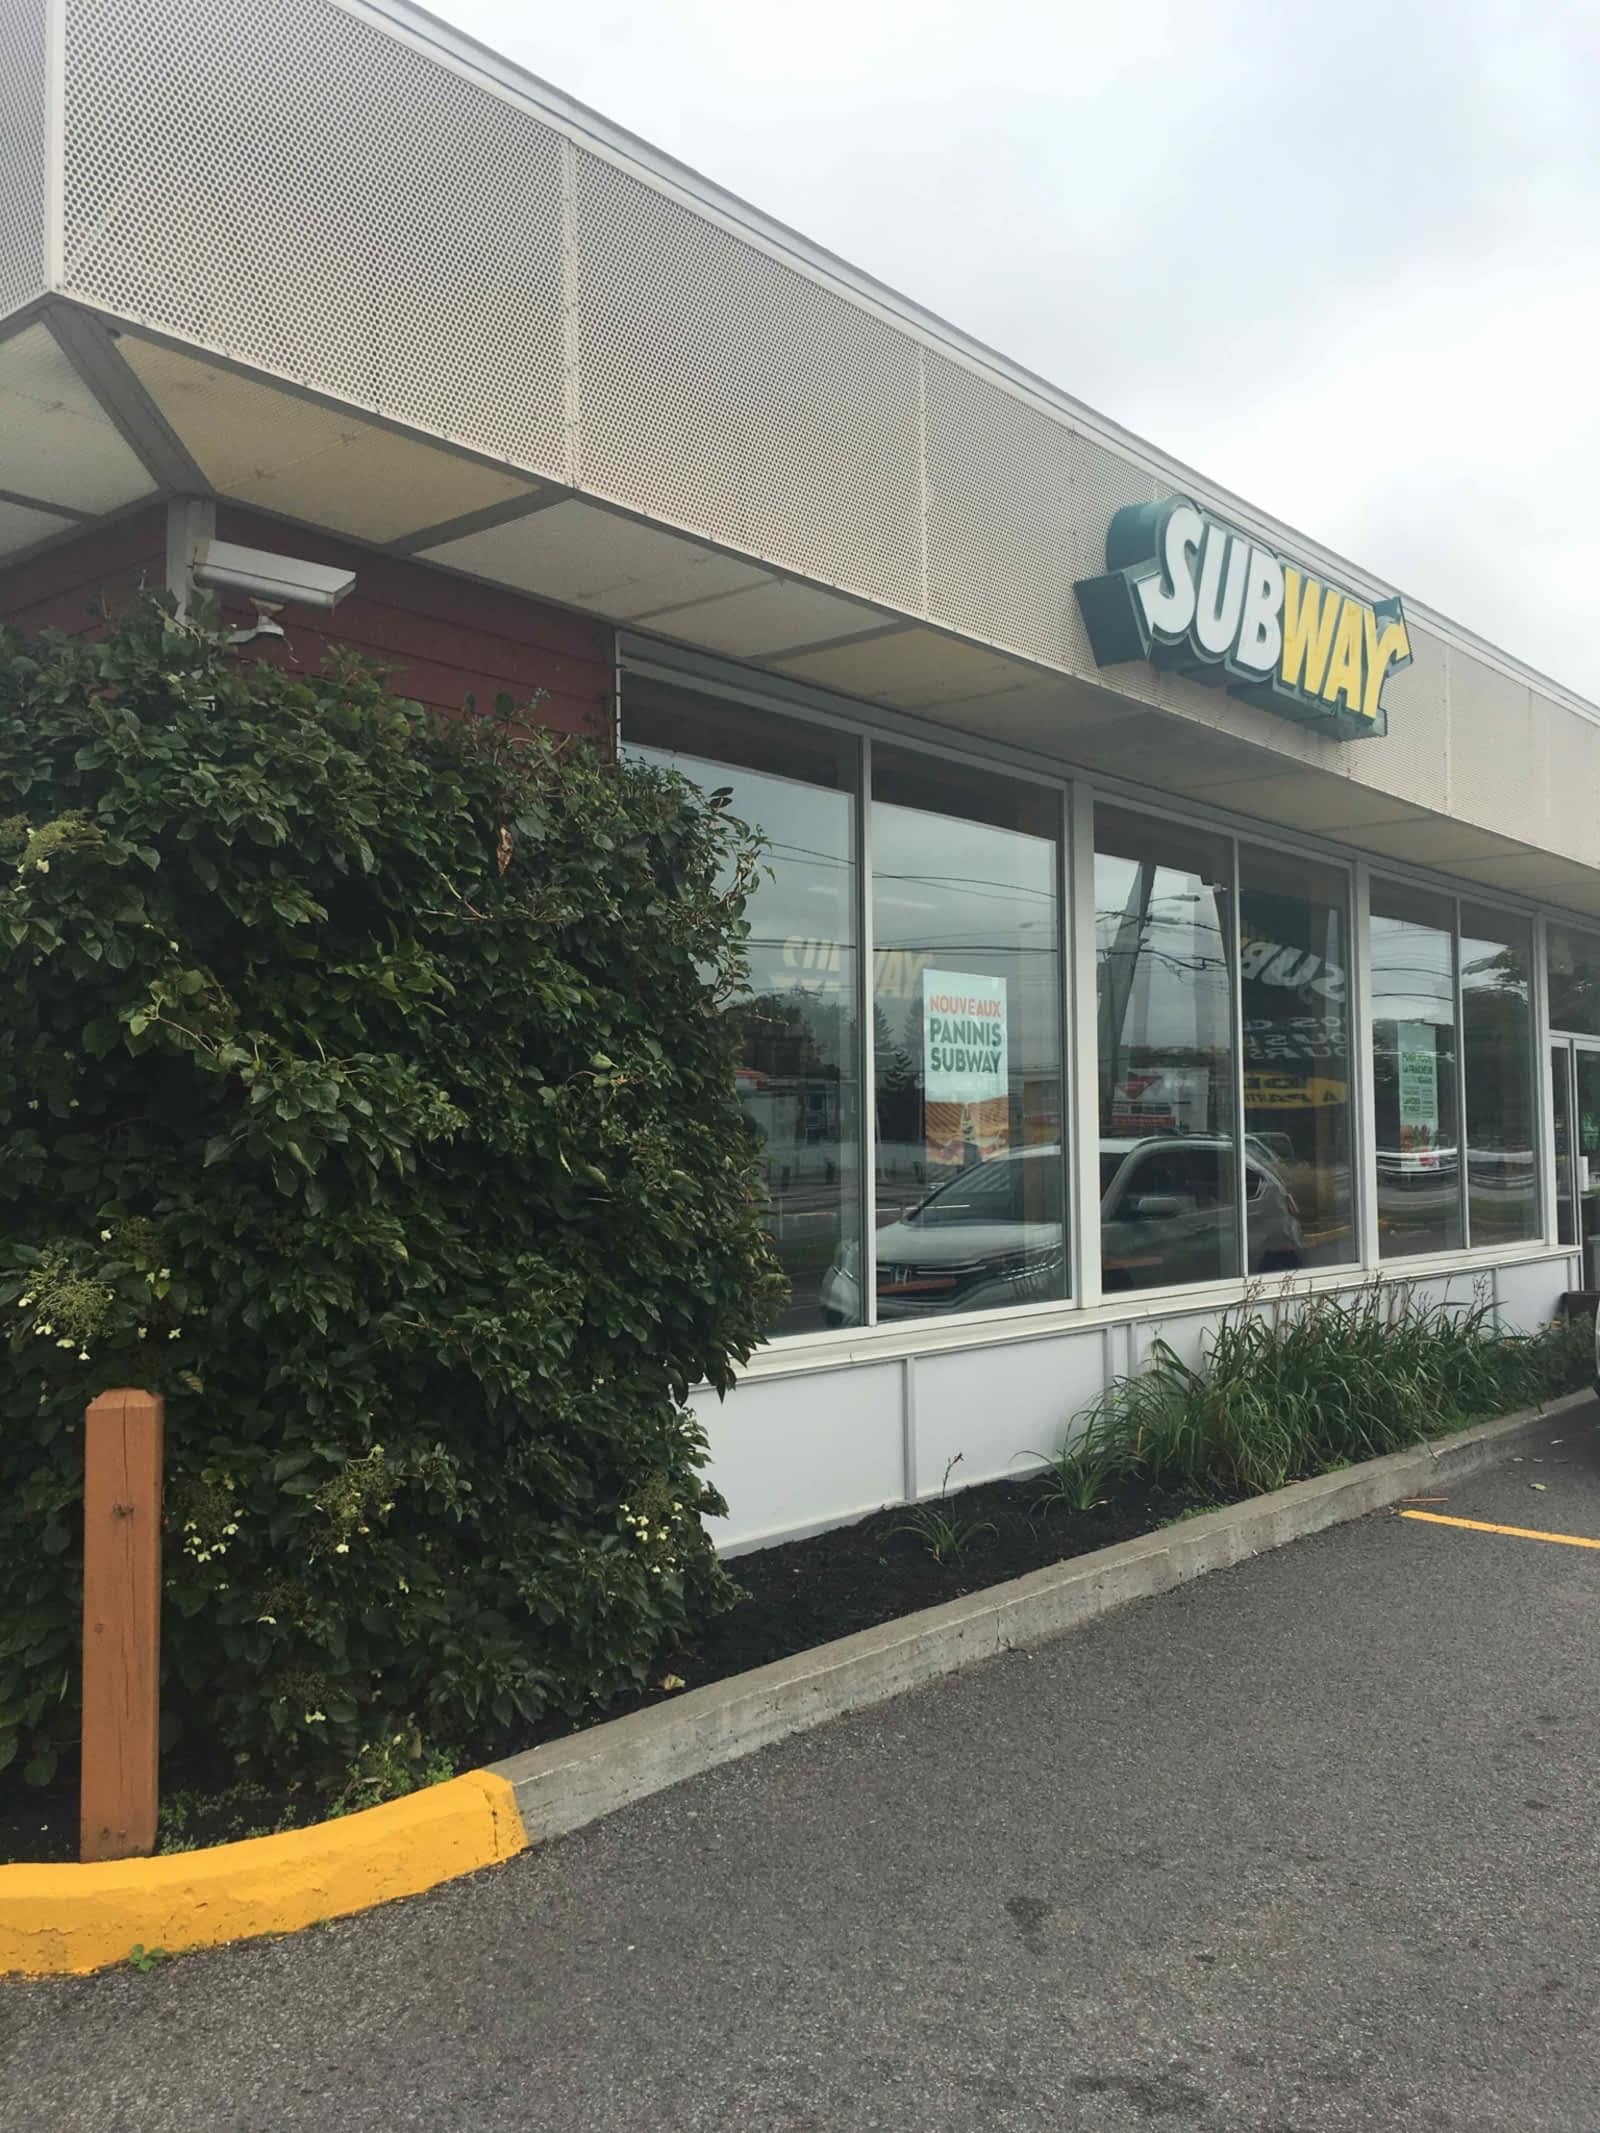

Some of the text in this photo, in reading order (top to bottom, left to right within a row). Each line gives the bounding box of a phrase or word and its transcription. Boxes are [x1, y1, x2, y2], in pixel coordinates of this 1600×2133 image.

[1136, 504, 1410, 719] SUBWAY
[930, 994, 1001, 1018] NOUVEAUX
[930, 1017, 1002, 1047] PANINIS
[930, 1047, 1002, 1075] SUBWAY
